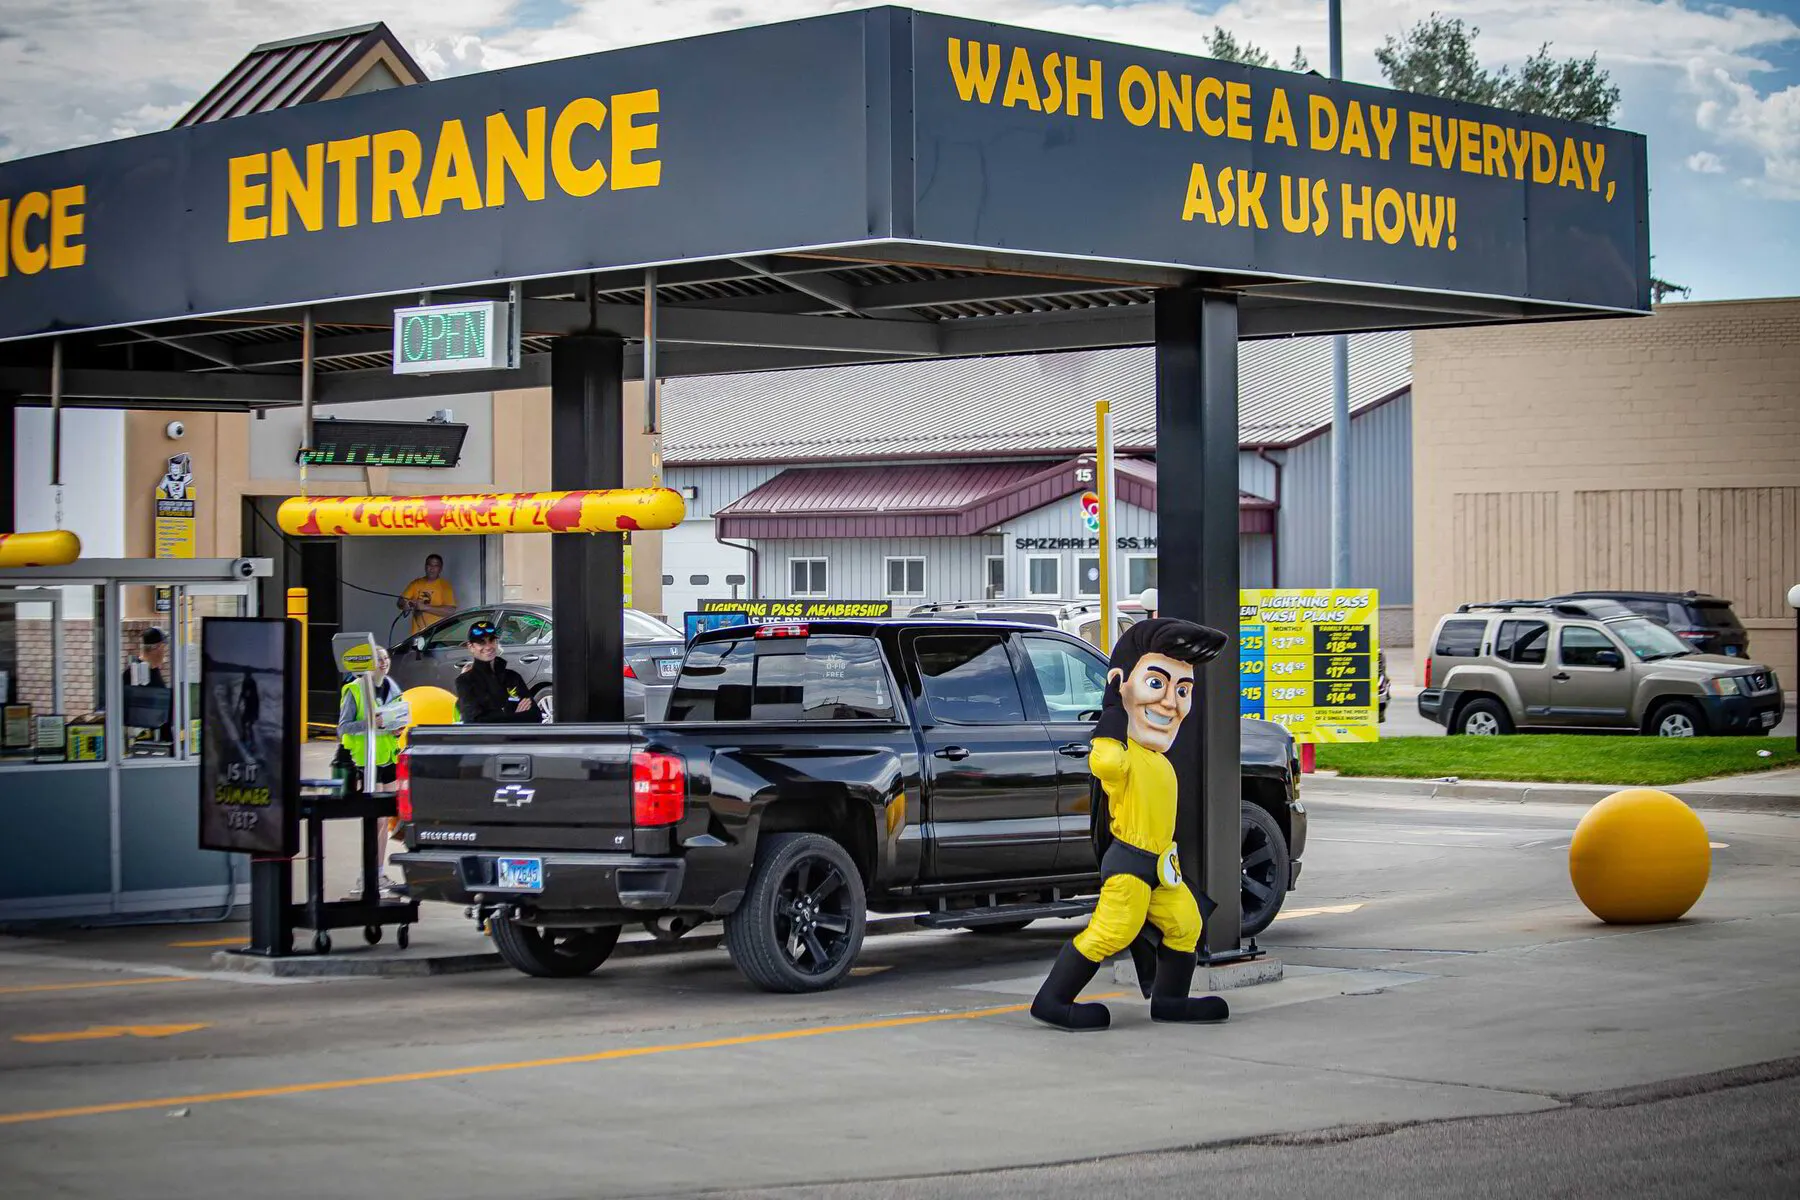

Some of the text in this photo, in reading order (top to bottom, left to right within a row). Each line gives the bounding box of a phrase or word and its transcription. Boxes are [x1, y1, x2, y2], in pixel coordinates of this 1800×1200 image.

[947, 37, 1616, 202] WASH ONCE A DAY EVERYDAY,
[227, 88, 661, 243] ENTRANCE
[1182, 162, 1457, 250] ASK US HOW!
[403, 309, 486, 361] OPEN
[1075, 468, 1093, 482] 15
[1015, 537, 1084, 550] SPIZZIRRI
[704, 603, 889, 617] LIGHTNING PASS MEMBERSHIP
[1260, 595, 1369, 609] LIGHTNING PASS
[1261, 610, 1345, 623] WASH PLANS
[1241, 687, 1262, 701] $15
[228, 762, 258, 782] IS IT
[216, 784, 270, 805] SUMMER
[229, 811, 258, 830] YET?
[420, 831, 477, 842] SILVERADO
